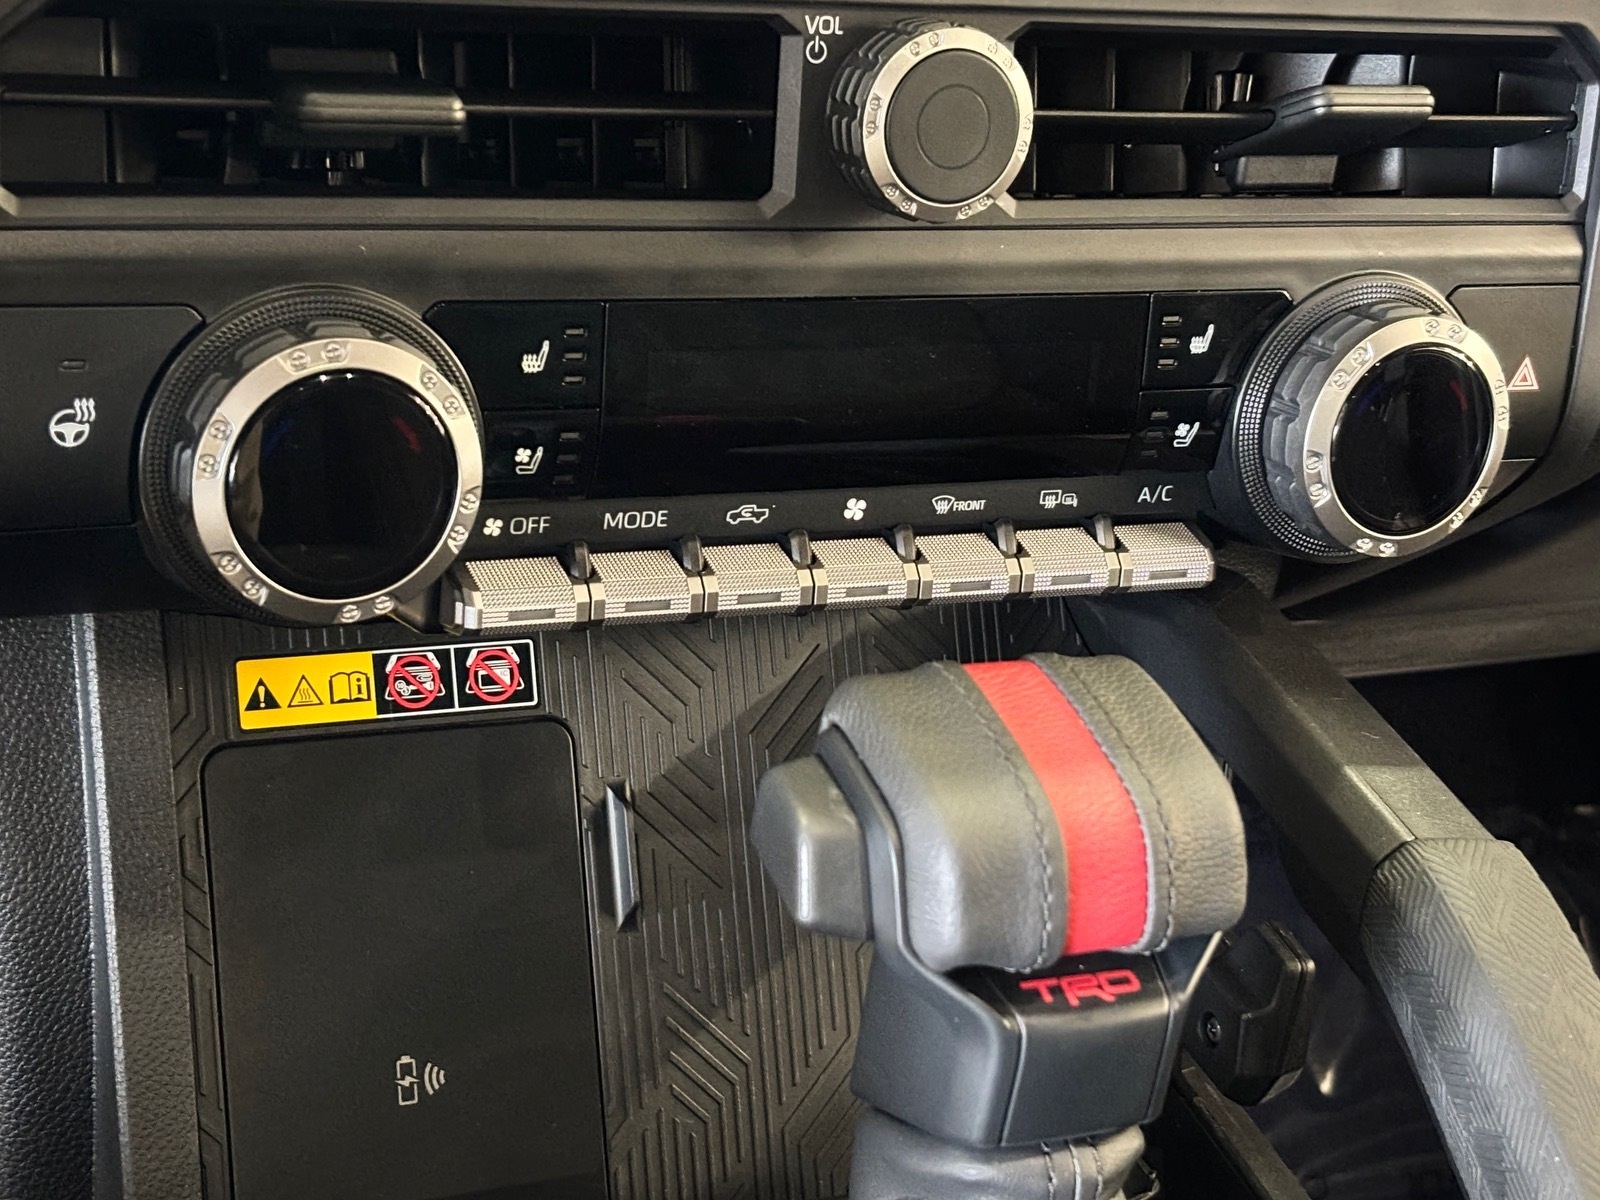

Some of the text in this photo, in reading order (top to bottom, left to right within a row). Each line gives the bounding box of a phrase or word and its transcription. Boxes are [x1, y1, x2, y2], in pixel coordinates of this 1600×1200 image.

[804, 15, 844, 35] VOL
[1137, 484, 1174, 504] A/C
[952, 499, 987, 512] FRONT
[509, 516, 551, 535] OFF
[603, 510, 669, 530] MODE
[1019, 968, 1142, 1008] TRD
